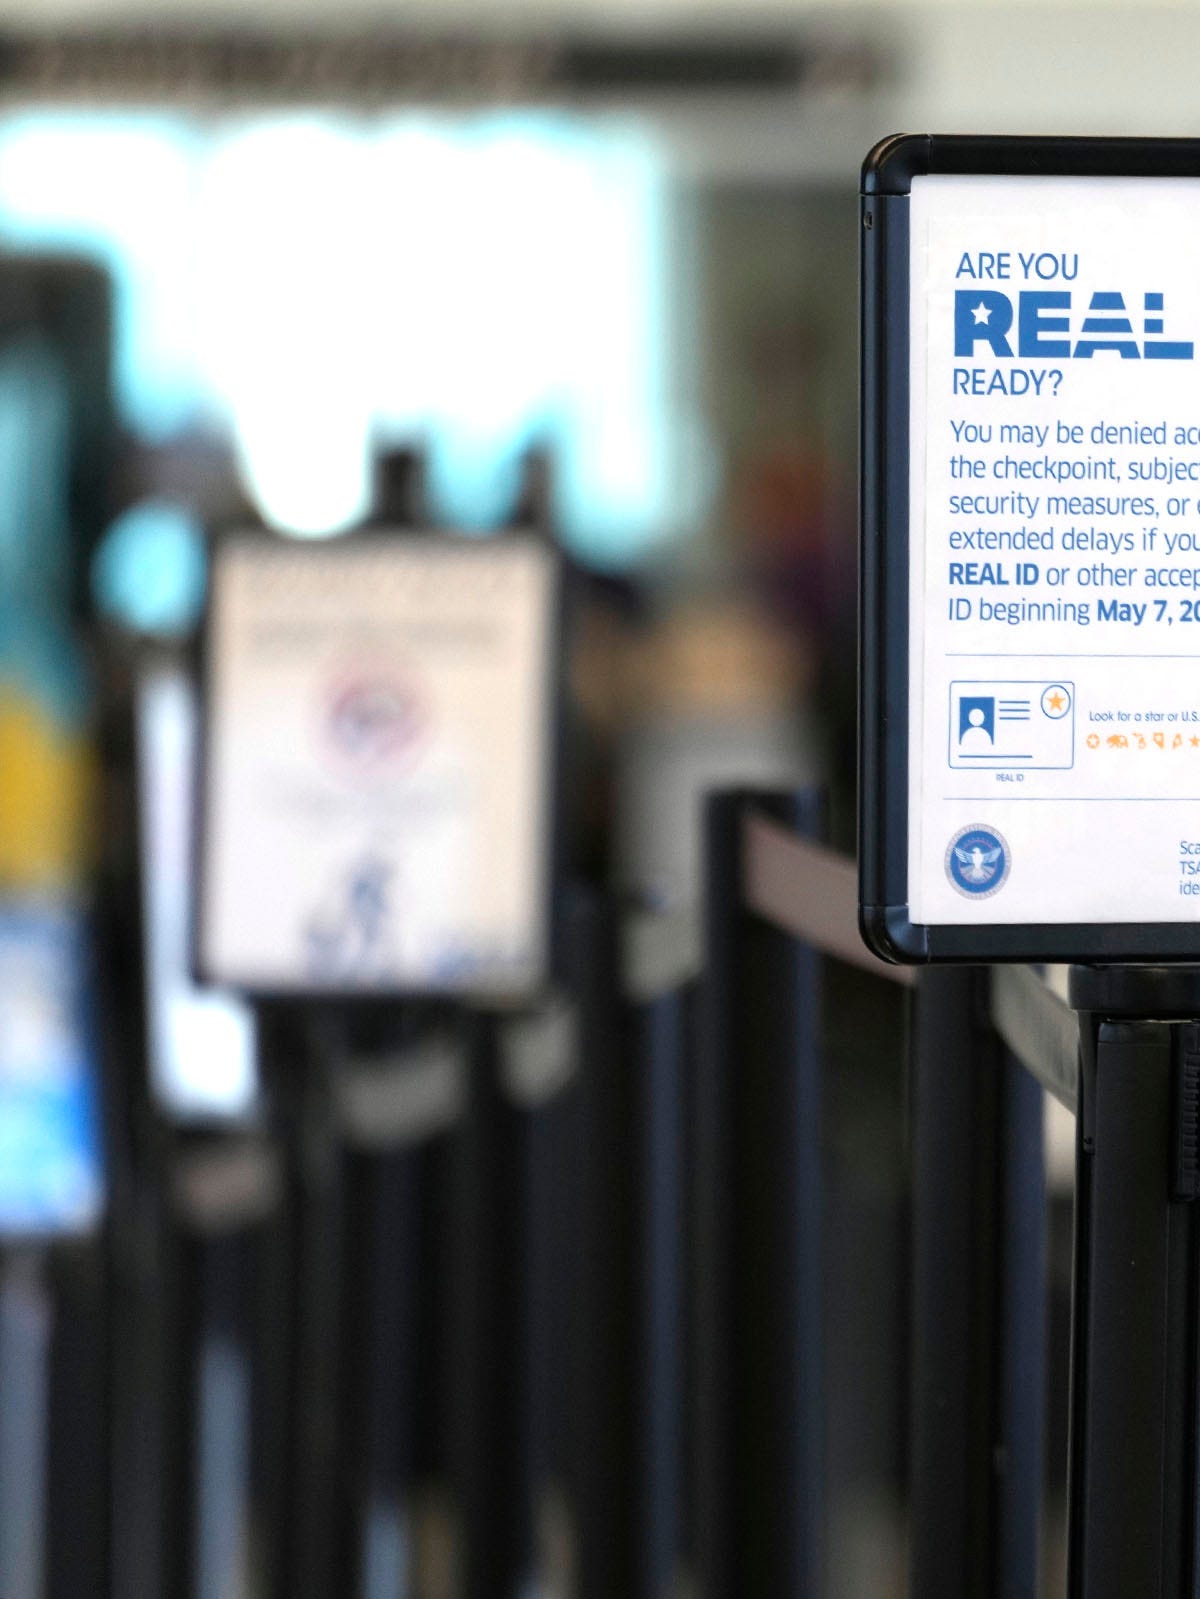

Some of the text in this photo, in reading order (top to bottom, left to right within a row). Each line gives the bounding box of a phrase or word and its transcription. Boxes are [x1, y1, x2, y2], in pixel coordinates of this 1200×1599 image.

[956, 252, 1078, 280] ARE YOU
[954, 290, 1194, 360] REAL
[953, 368, 1063, 396] READY?
[950, 420, 992, 443] You
[1001, 425, 1049, 447] may
[1057, 420, 1084, 444] be
[1091, 421, 1166, 445] denied
[950, 455, 986, 478] the
[993, 455, 1120, 483] checkpoint,
[950, 491, 1039, 518] security
[1048, 497, 1159, 518] measures,
[1167, 498, 1190, 516] or
[949, 527, 1054, 550] extended
[1062, 527, 1134, 554] delays
[1143, 528, 1158, 551] if
[949, 563, 1009, 585] REAL
[1016, 563, 1039, 585] ID
[1046, 568, 1070, 586] or
[1077, 563, 1137, 586] other
[949, 598, 972, 621] ID
[980, 597, 1090, 625] beginning
[1098, 599, 1147, 625] May
[1153, 600, 1172, 625] 7,
[1090, 712, 1113, 721] Look
[1117, 711, 1131, 721] for
[1134, 713, 1142, 721] a
[1145, 712, 1164, 721] star
[1167, 713, 1178, 721] or
[1182, 712, 1200, 722] U.S.
